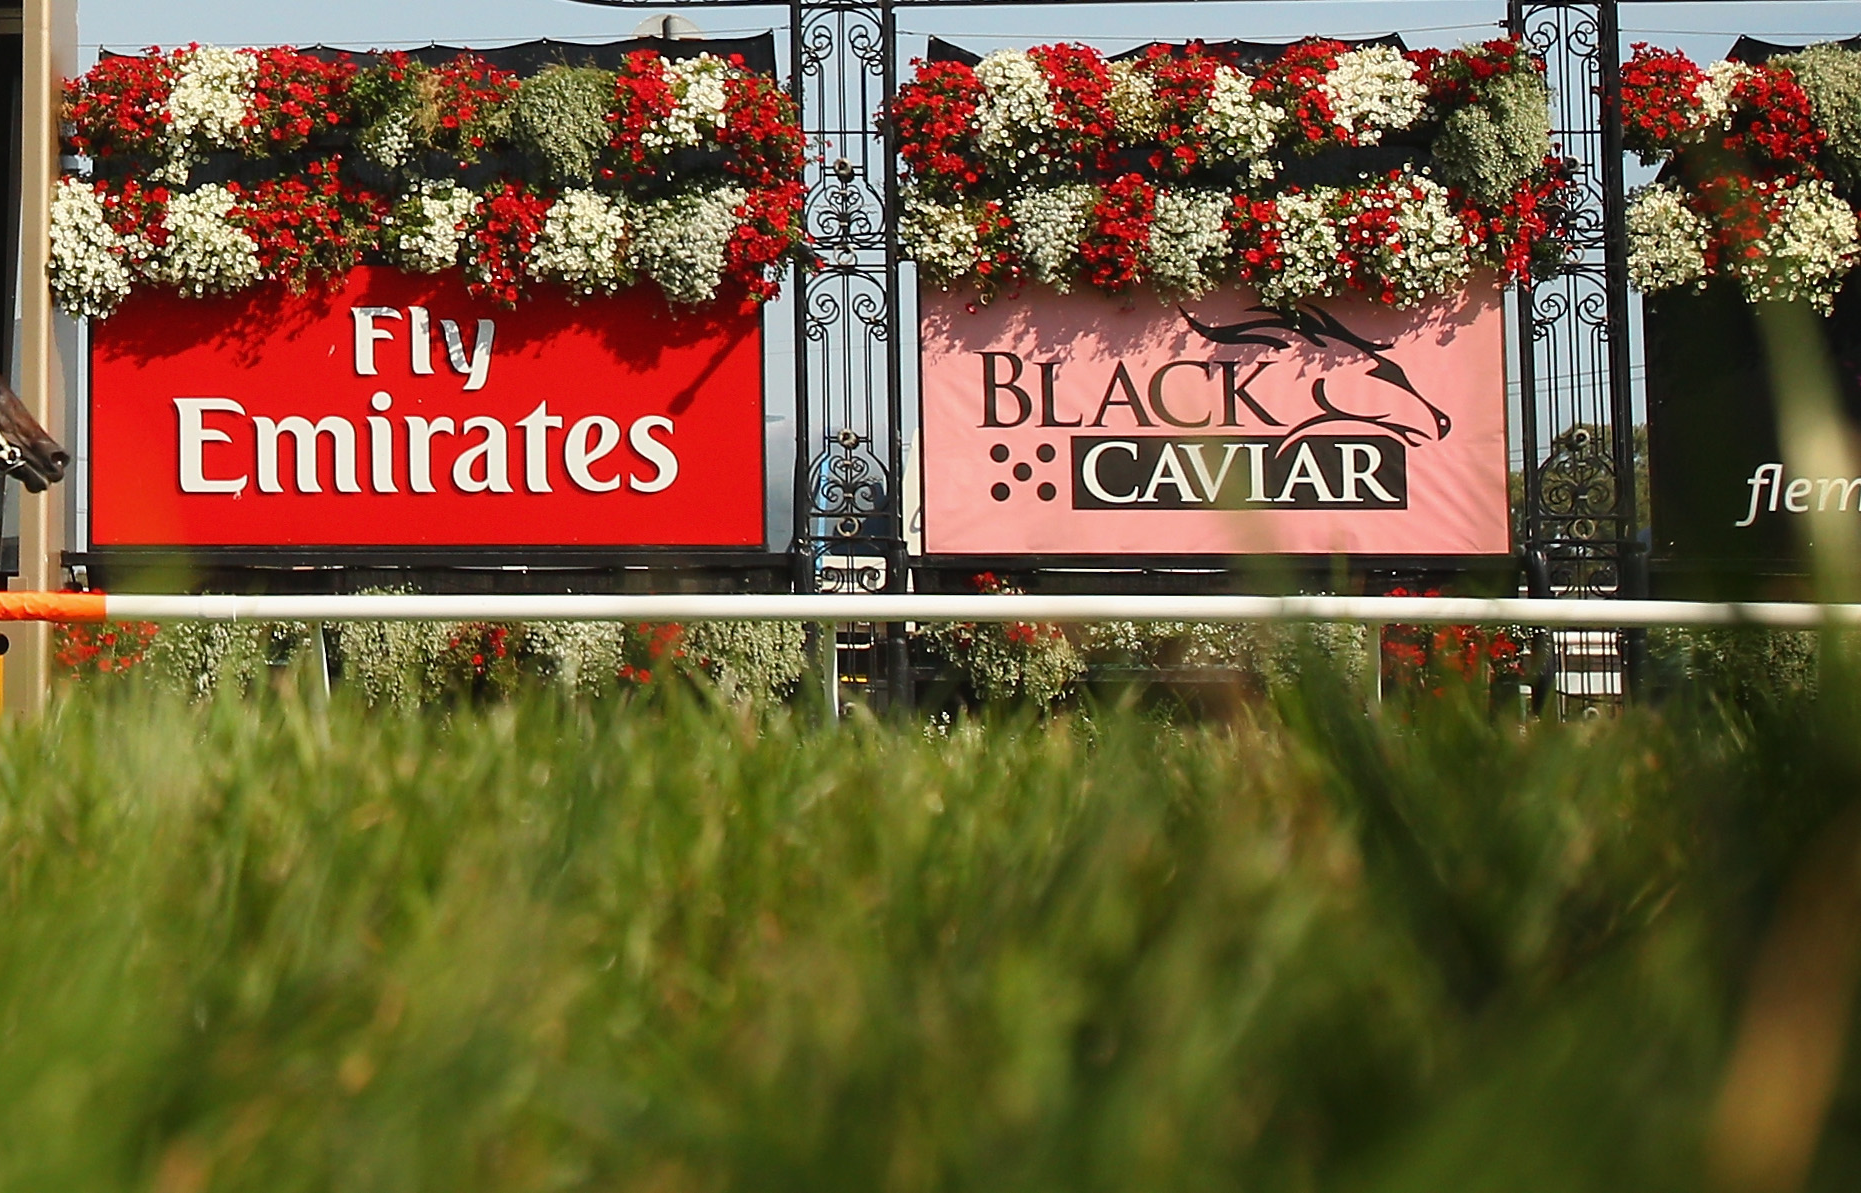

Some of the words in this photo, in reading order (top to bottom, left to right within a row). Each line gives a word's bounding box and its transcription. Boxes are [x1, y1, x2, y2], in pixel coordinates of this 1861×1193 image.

[350, 306, 495, 390] Fly
[978, 351, 1288, 428] BLACK
[172, 391, 680, 494] Emirates
[1080, 441, 1400, 504] CAVIAR
